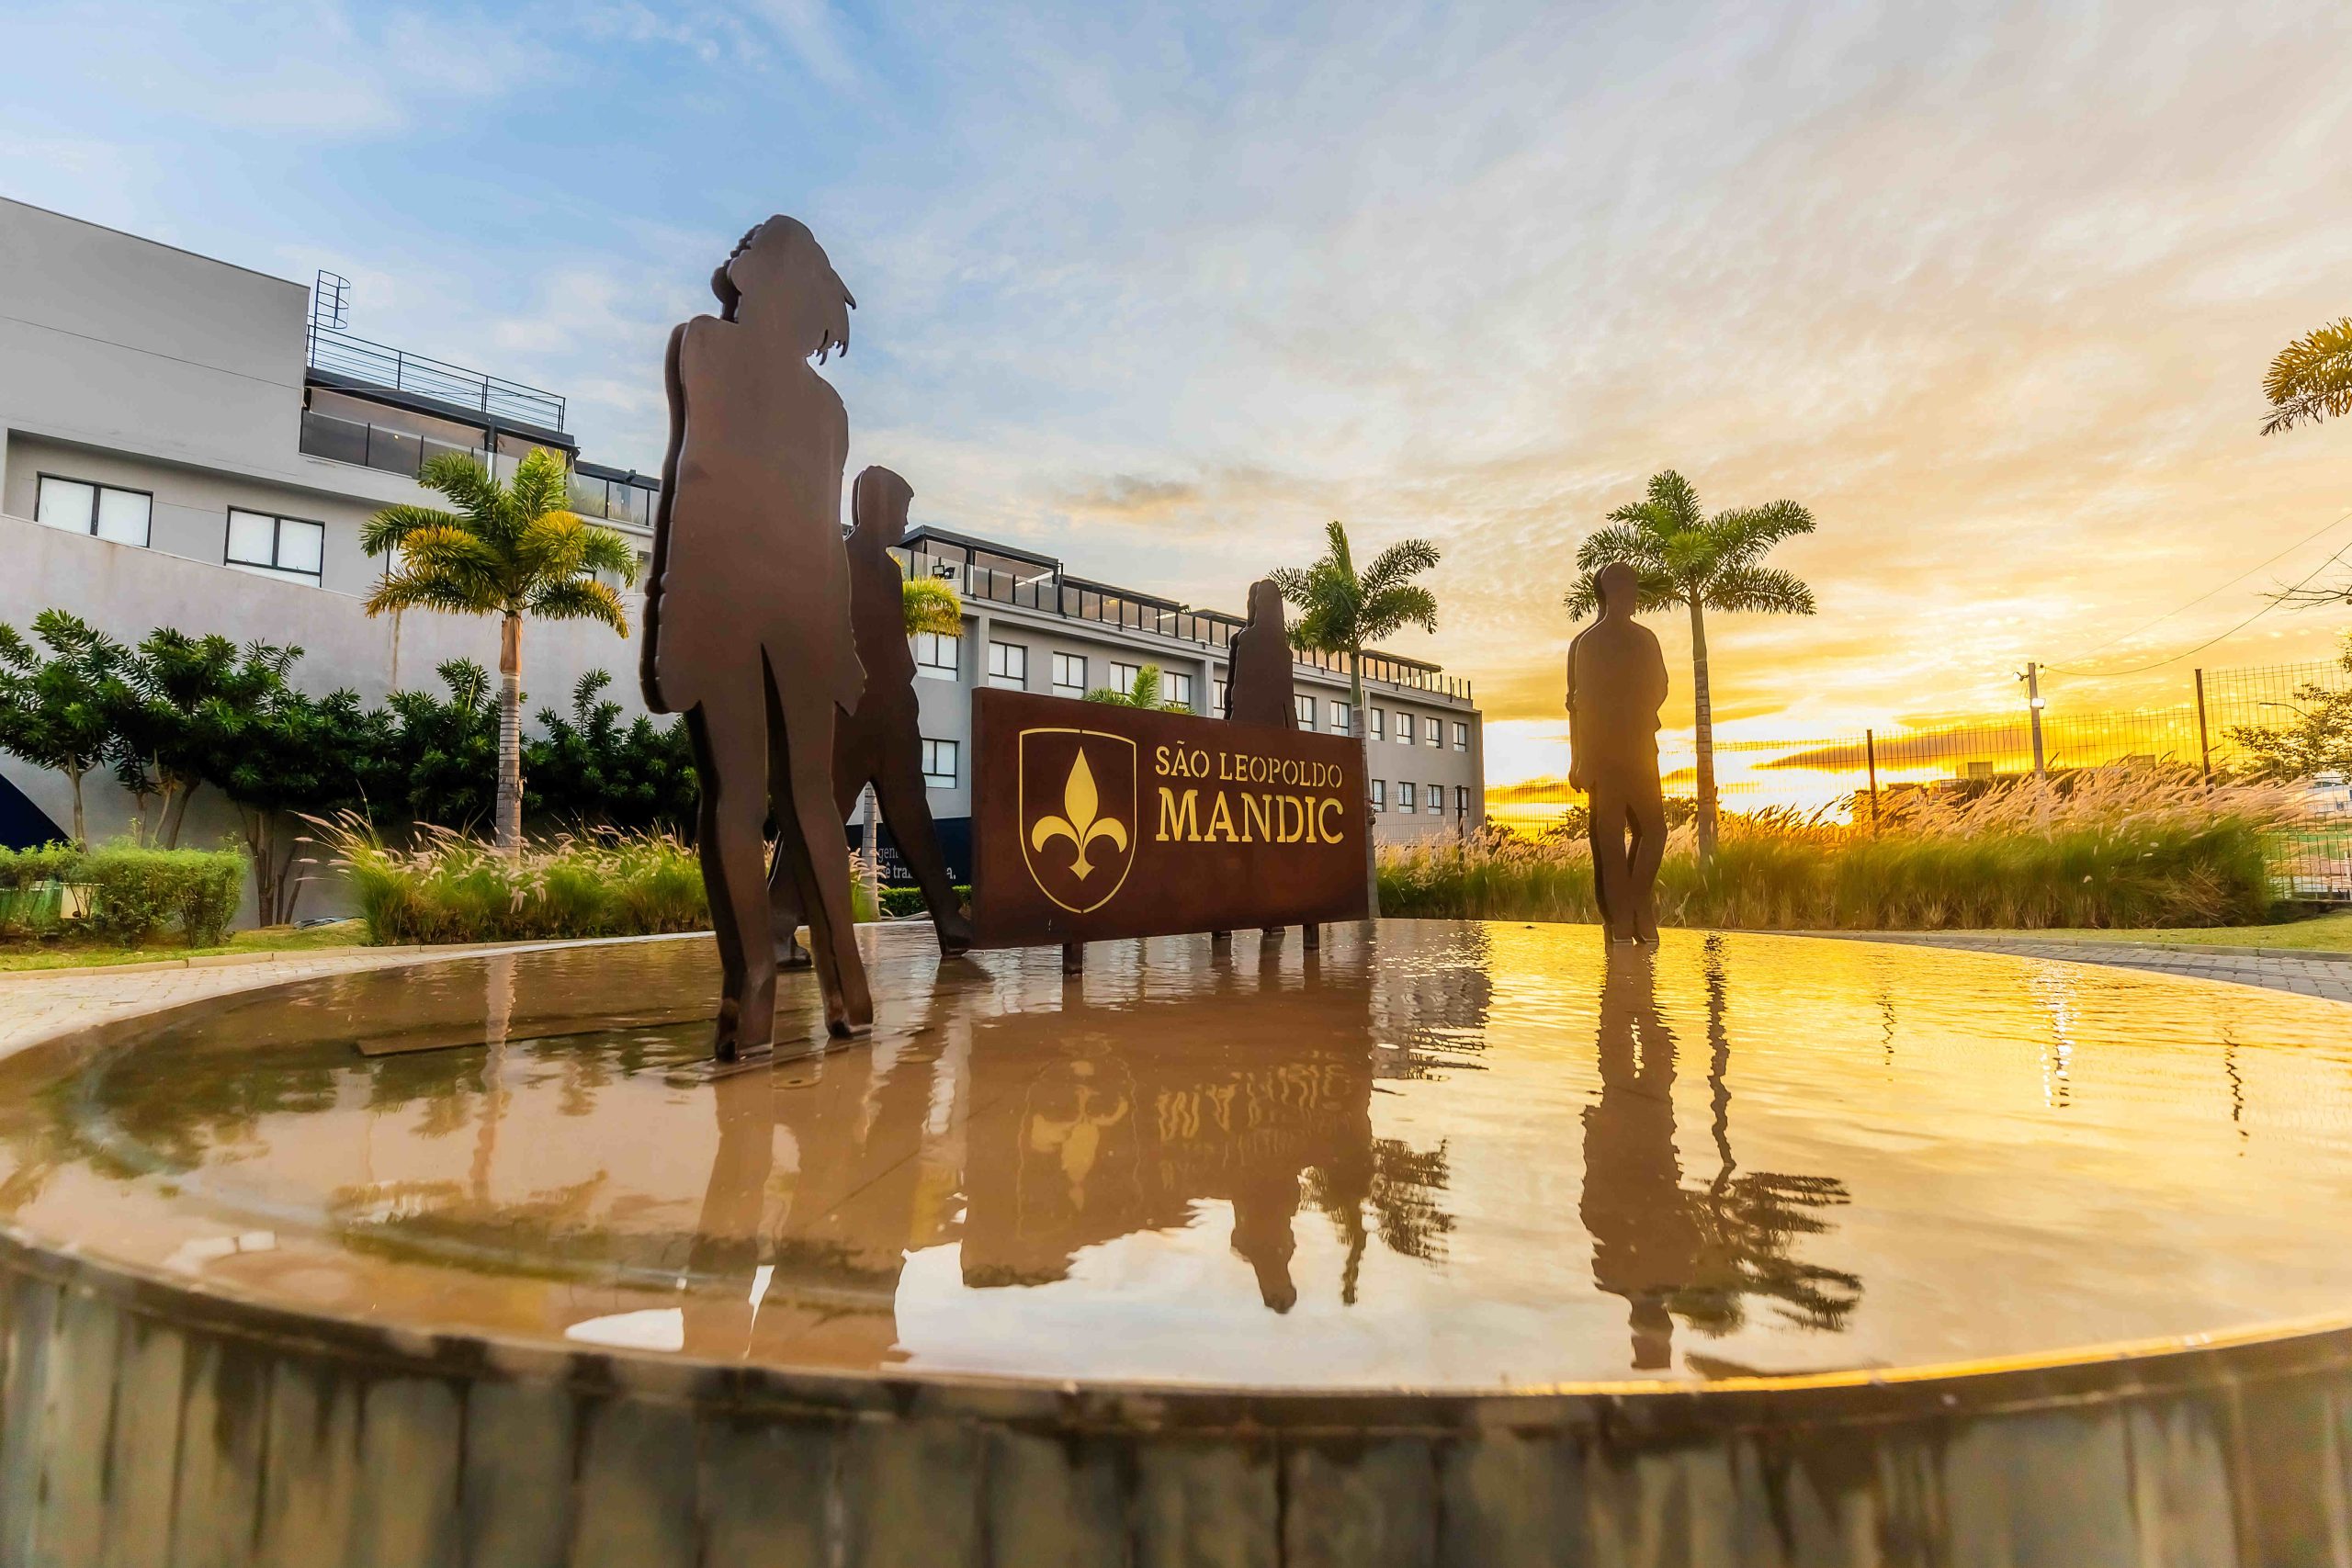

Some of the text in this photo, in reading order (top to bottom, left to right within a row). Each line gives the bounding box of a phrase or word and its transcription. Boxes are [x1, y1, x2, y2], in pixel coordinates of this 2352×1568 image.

[1155, 740, 1342, 788] SÃO LEOPOLDO
[1155, 786, 1344, 844] MANDIC
